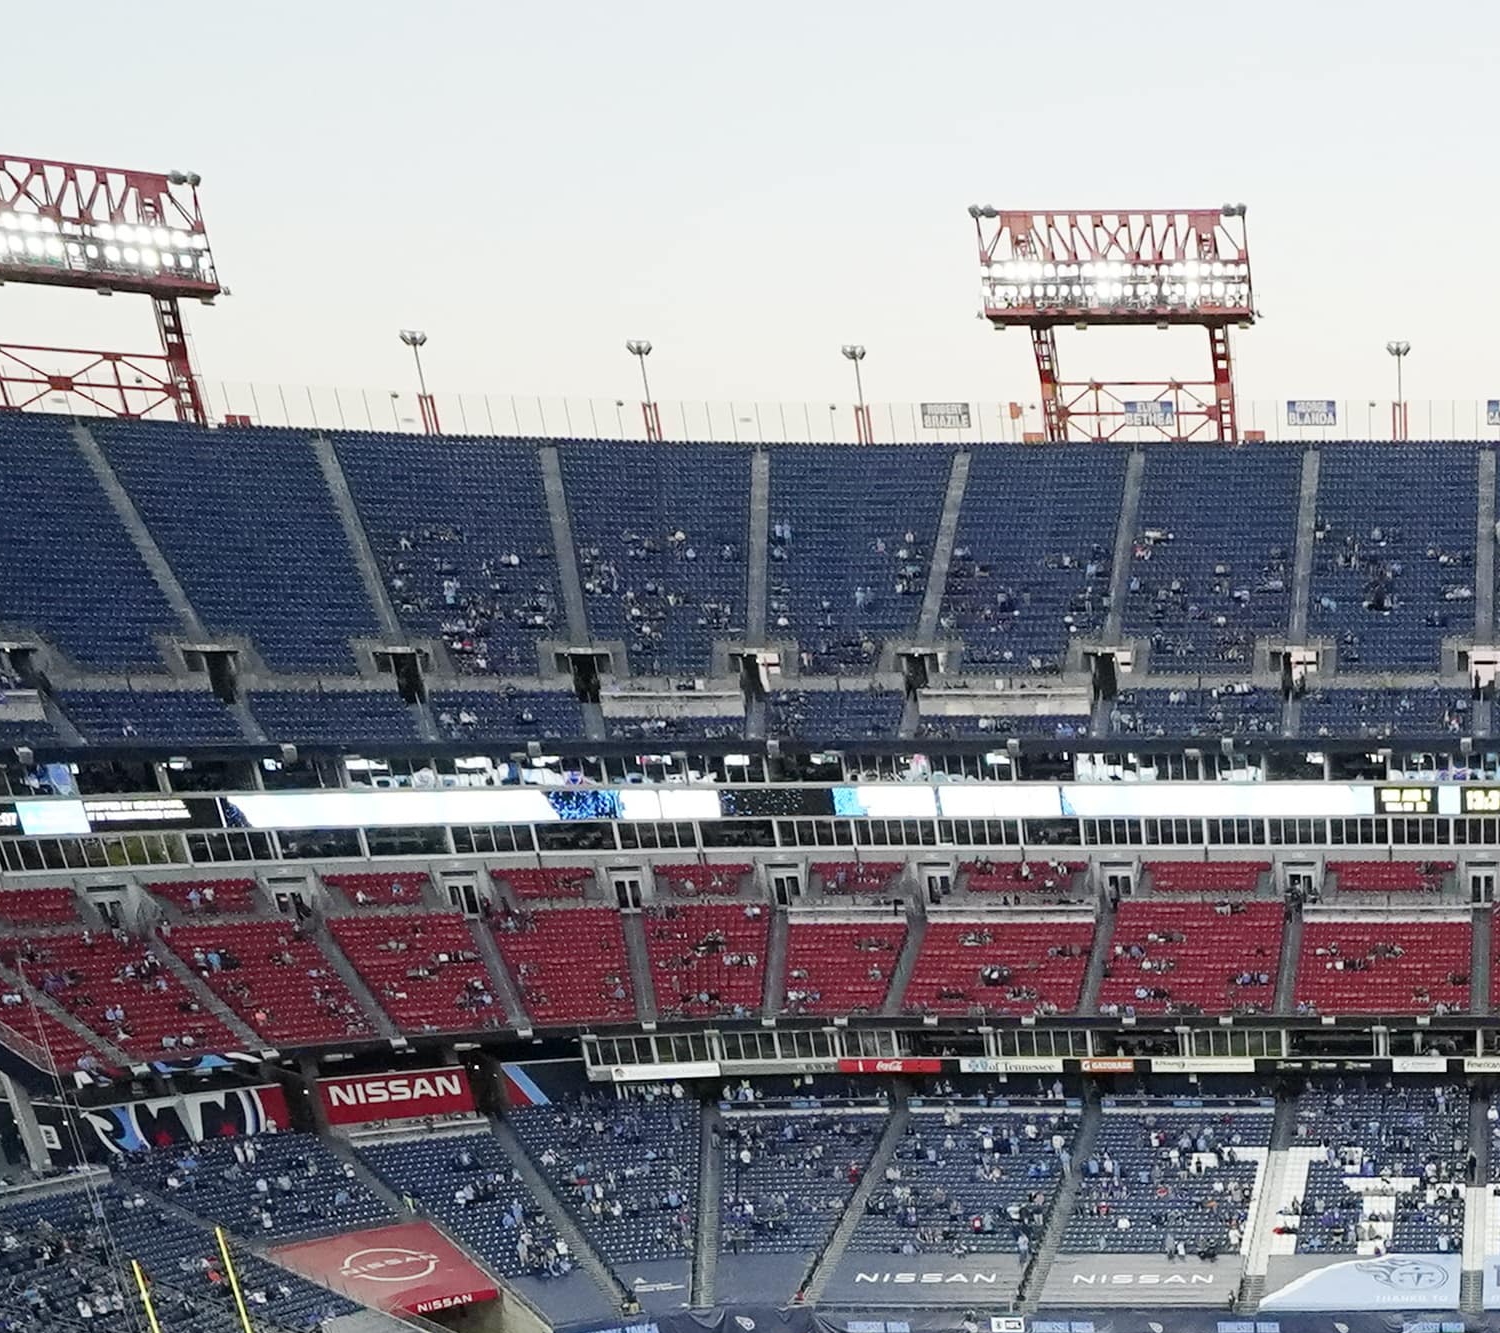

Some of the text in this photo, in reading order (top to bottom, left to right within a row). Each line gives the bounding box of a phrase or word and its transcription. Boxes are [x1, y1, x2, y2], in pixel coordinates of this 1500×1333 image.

[328, 1075, 464, 1109] NISSAN
[339, 1252, 440, 1278] NISSAN
[854, 1272, 997, 1285] NISSAN
[1073, 1273, 1214, 1286] NISSAN
[417, 1293, 474, 1313] NISSAN
